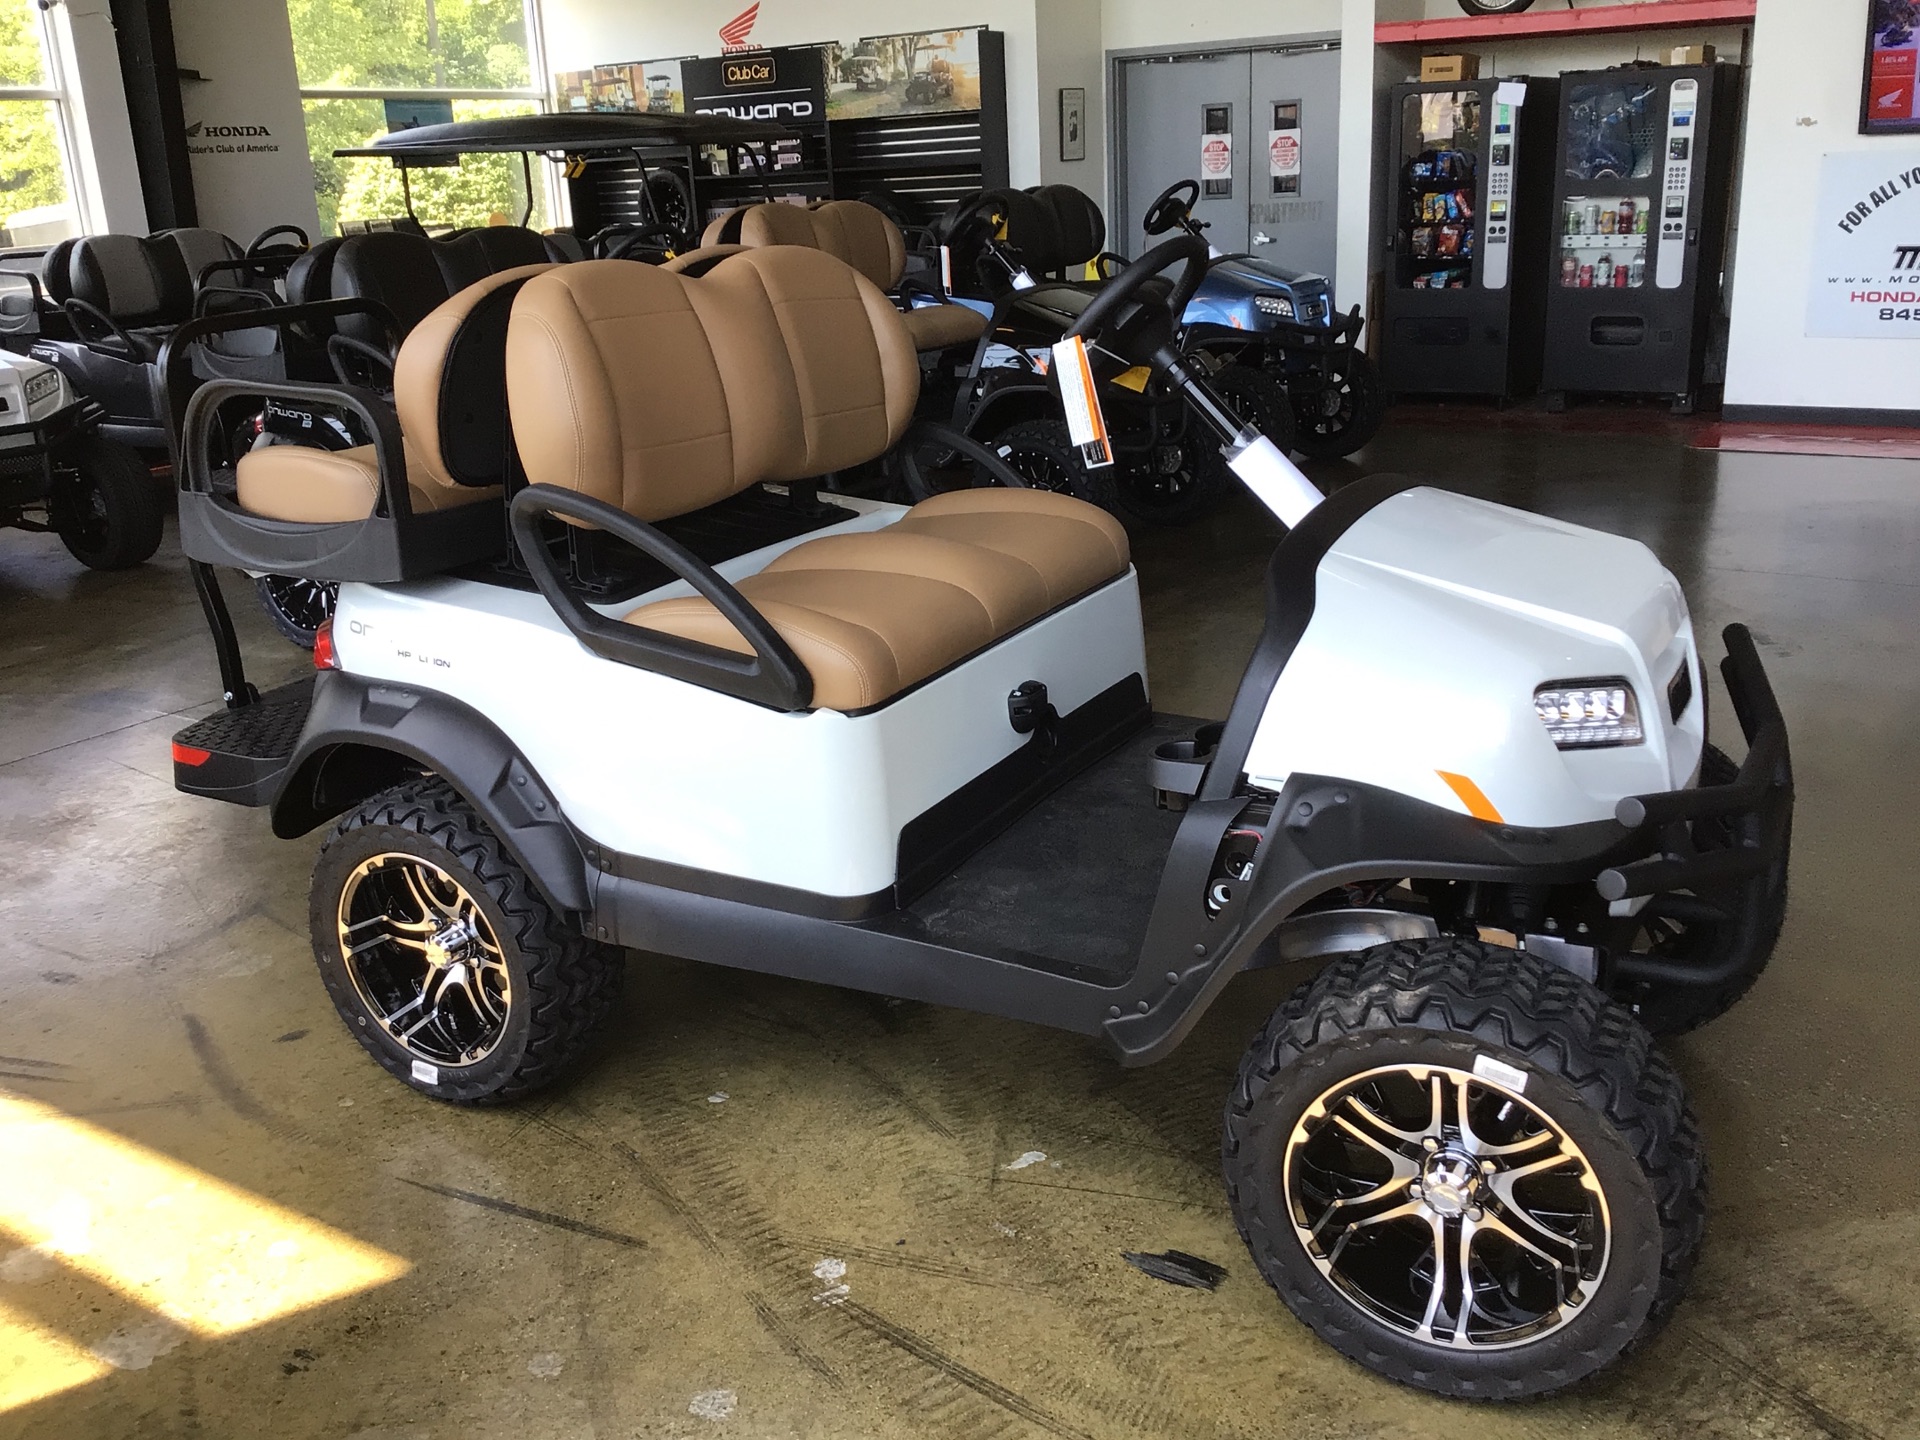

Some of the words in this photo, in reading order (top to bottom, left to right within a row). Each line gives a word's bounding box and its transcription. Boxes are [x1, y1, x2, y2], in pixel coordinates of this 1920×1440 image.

[728, 66, 751, 80] Club
[751, 64, 770, 79] Car
[204, 126, 271, 137] HONDA
[216, 144, 235, 153] Club
[237, 145, 244, 153] of
[246, 143, 278, 153] America
[1208, 143, 1225, 152] STOP
[1276, 139, 1294, 148] STOP
[1837, 201, 1872, 234] FOR
[1869, 180, 1901, 208] ALL
[433, 658, 451, 668] ION
